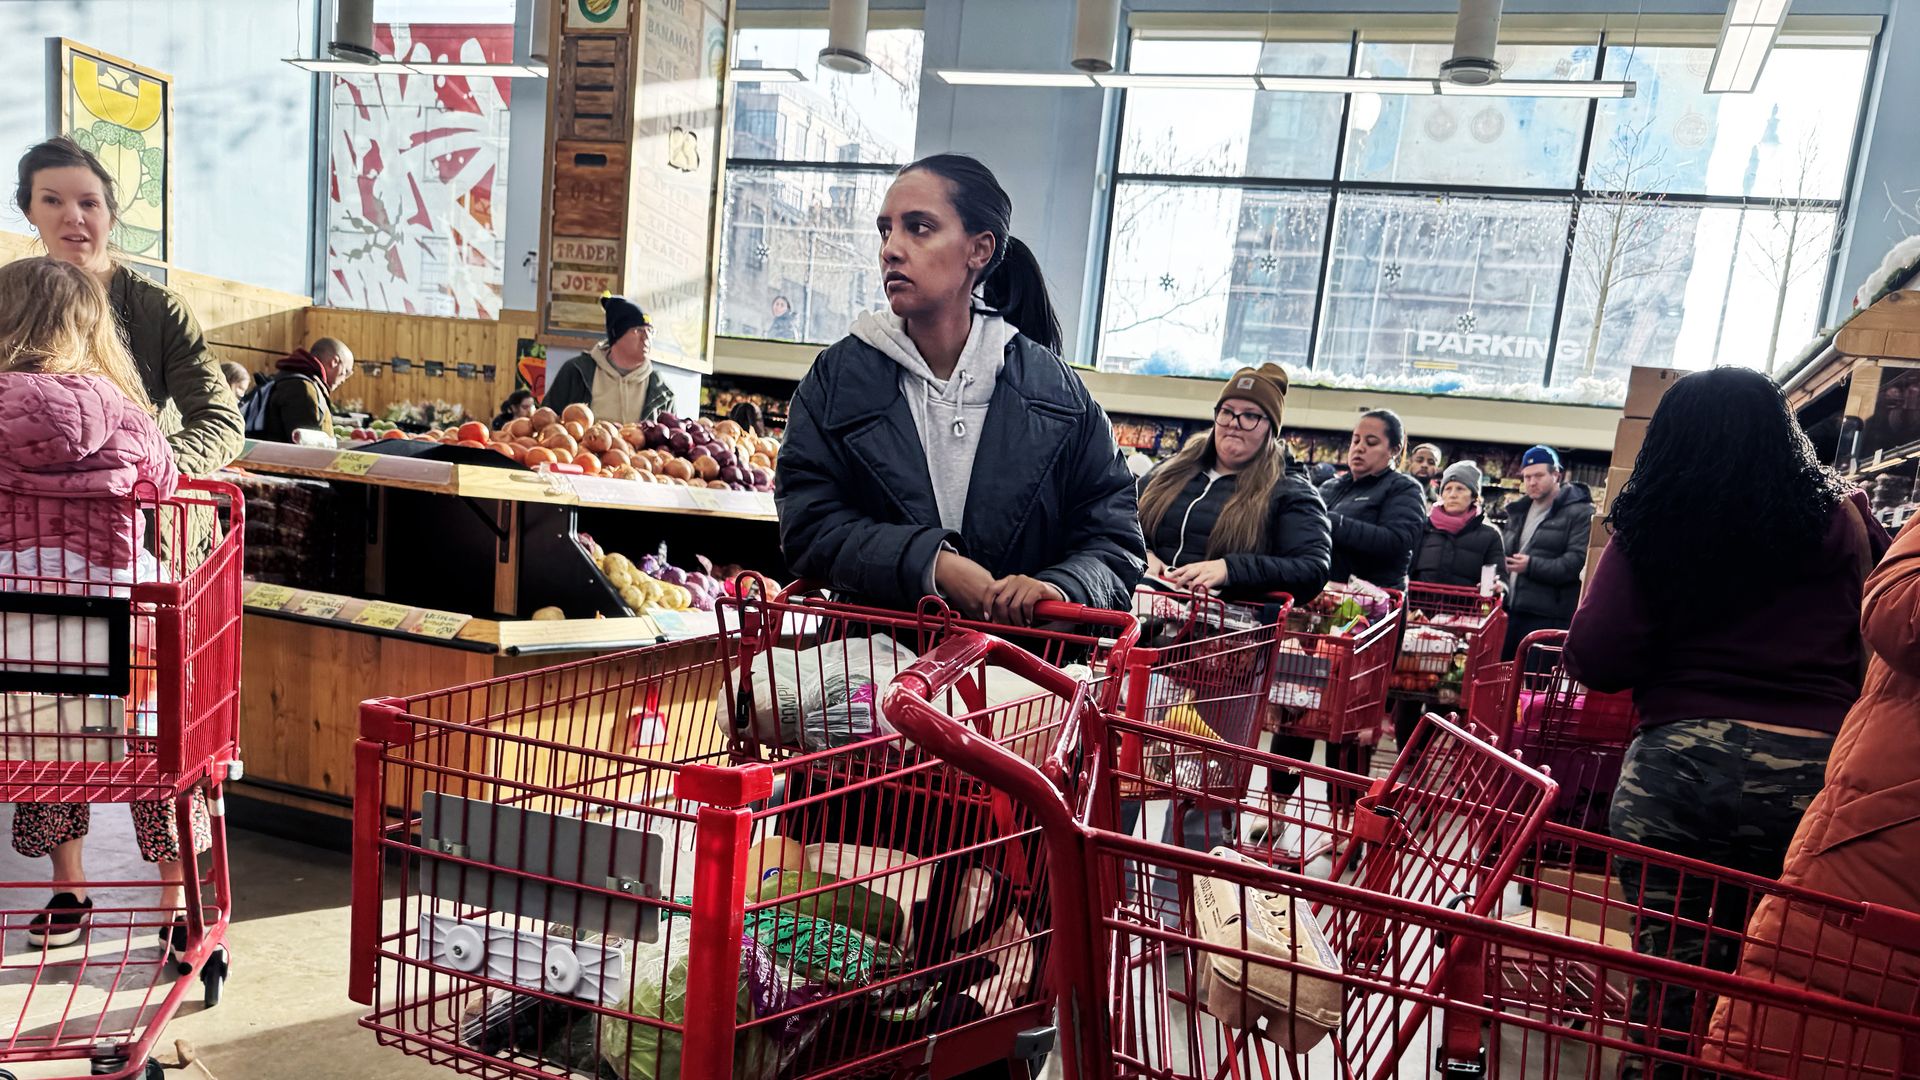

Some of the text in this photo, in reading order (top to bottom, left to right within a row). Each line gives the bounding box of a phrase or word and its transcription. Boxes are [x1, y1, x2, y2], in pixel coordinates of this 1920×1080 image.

[647, 19, 695, 57] BANANAS
[656, 56, 679, 81] ARE
[556, 243, 616, 261] TRADER
[561, 274, 609, 292] JOE'S
[1416, 330, 1583, 362] PARKING
